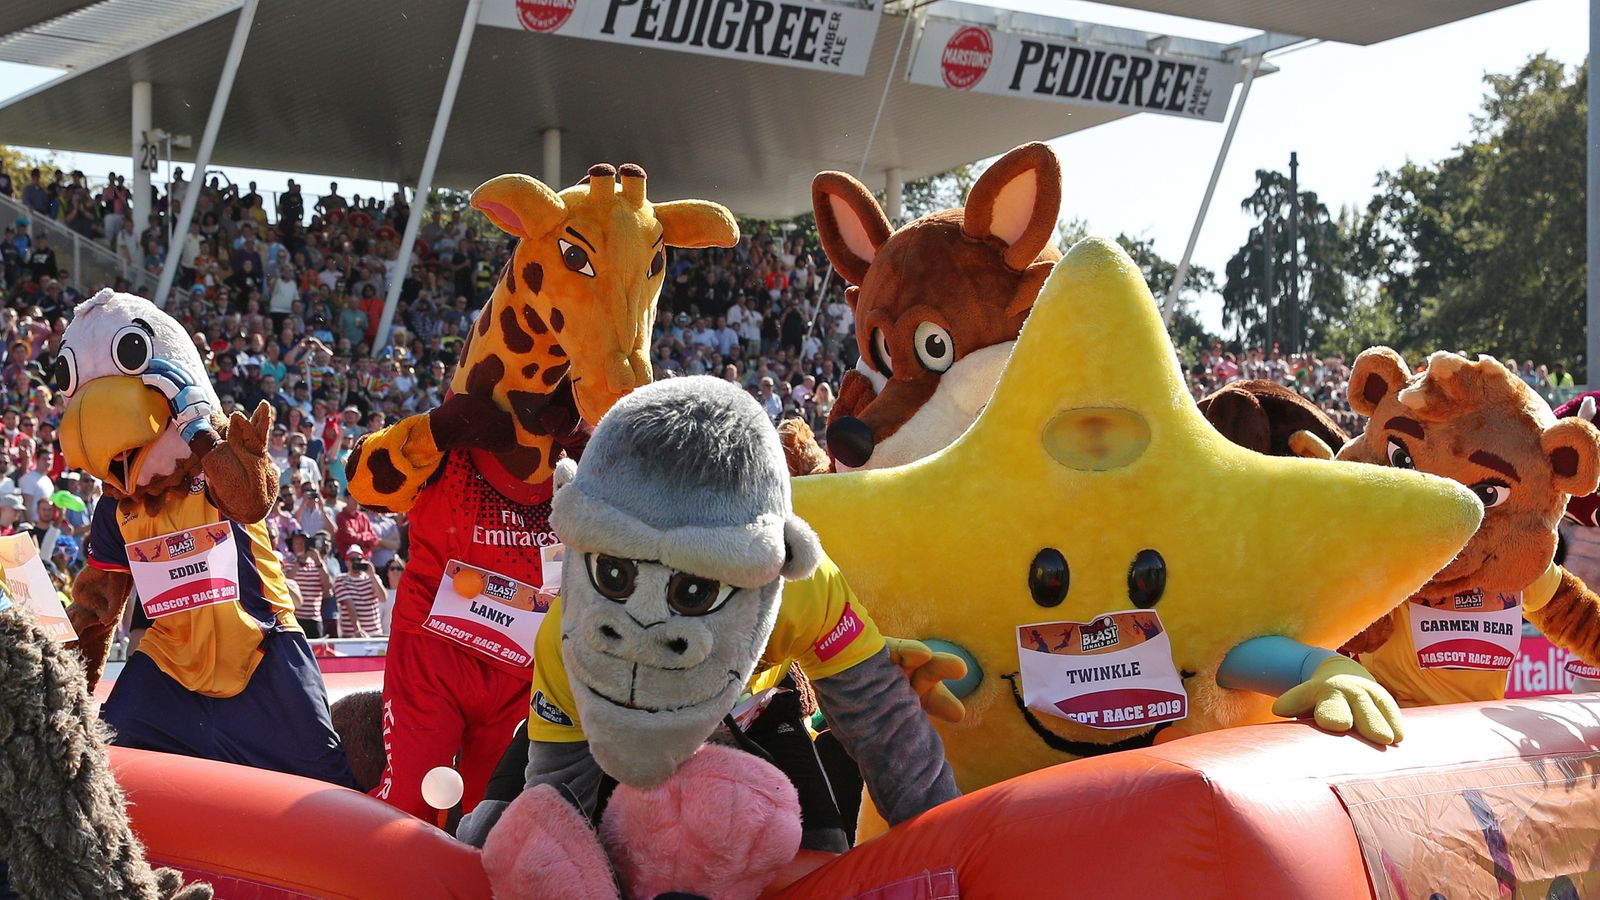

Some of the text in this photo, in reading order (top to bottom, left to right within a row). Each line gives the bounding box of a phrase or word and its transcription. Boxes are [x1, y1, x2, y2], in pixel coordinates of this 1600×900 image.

[601, 0, 827, 62] PEDIGREE
[819, 11, 842, 65] AMBER
[831, 36, 847, 67] ALE
[1009, 40, 1196, 112] PEDIGREE
[140, 143, 158, 172] 28
[502, 510, 525, 527] Fly
[168, 538, 194, 554] BLAST
[473, 525, 559, 546] Emirates
[168, 561, 208, 580] EDDIE
[146, 596, 190, 614] MASCOT
[192, 588, 220, 604] RACE
[487, 583, 517, 597] BLAST
[1455, 594, 1483, 605] BLAST
[469, 601, 515, 628] LANKY
[1082, 626, 1117, 646] BLAST
[1420, 620, 1514, 636] CARMEN BEAR
[429, 618, 527, 664] MASCOT RACE 2019
[1083, 638, 1118, 651] FINALS DAY
[1421, 651, 1512, 667] MASCOT RACE 2019
[1066, 661, 1142, 684] TWINKLE
[1103, 705, 1144, 723] RACE
[1148, 699, 1182, 718] 2019
